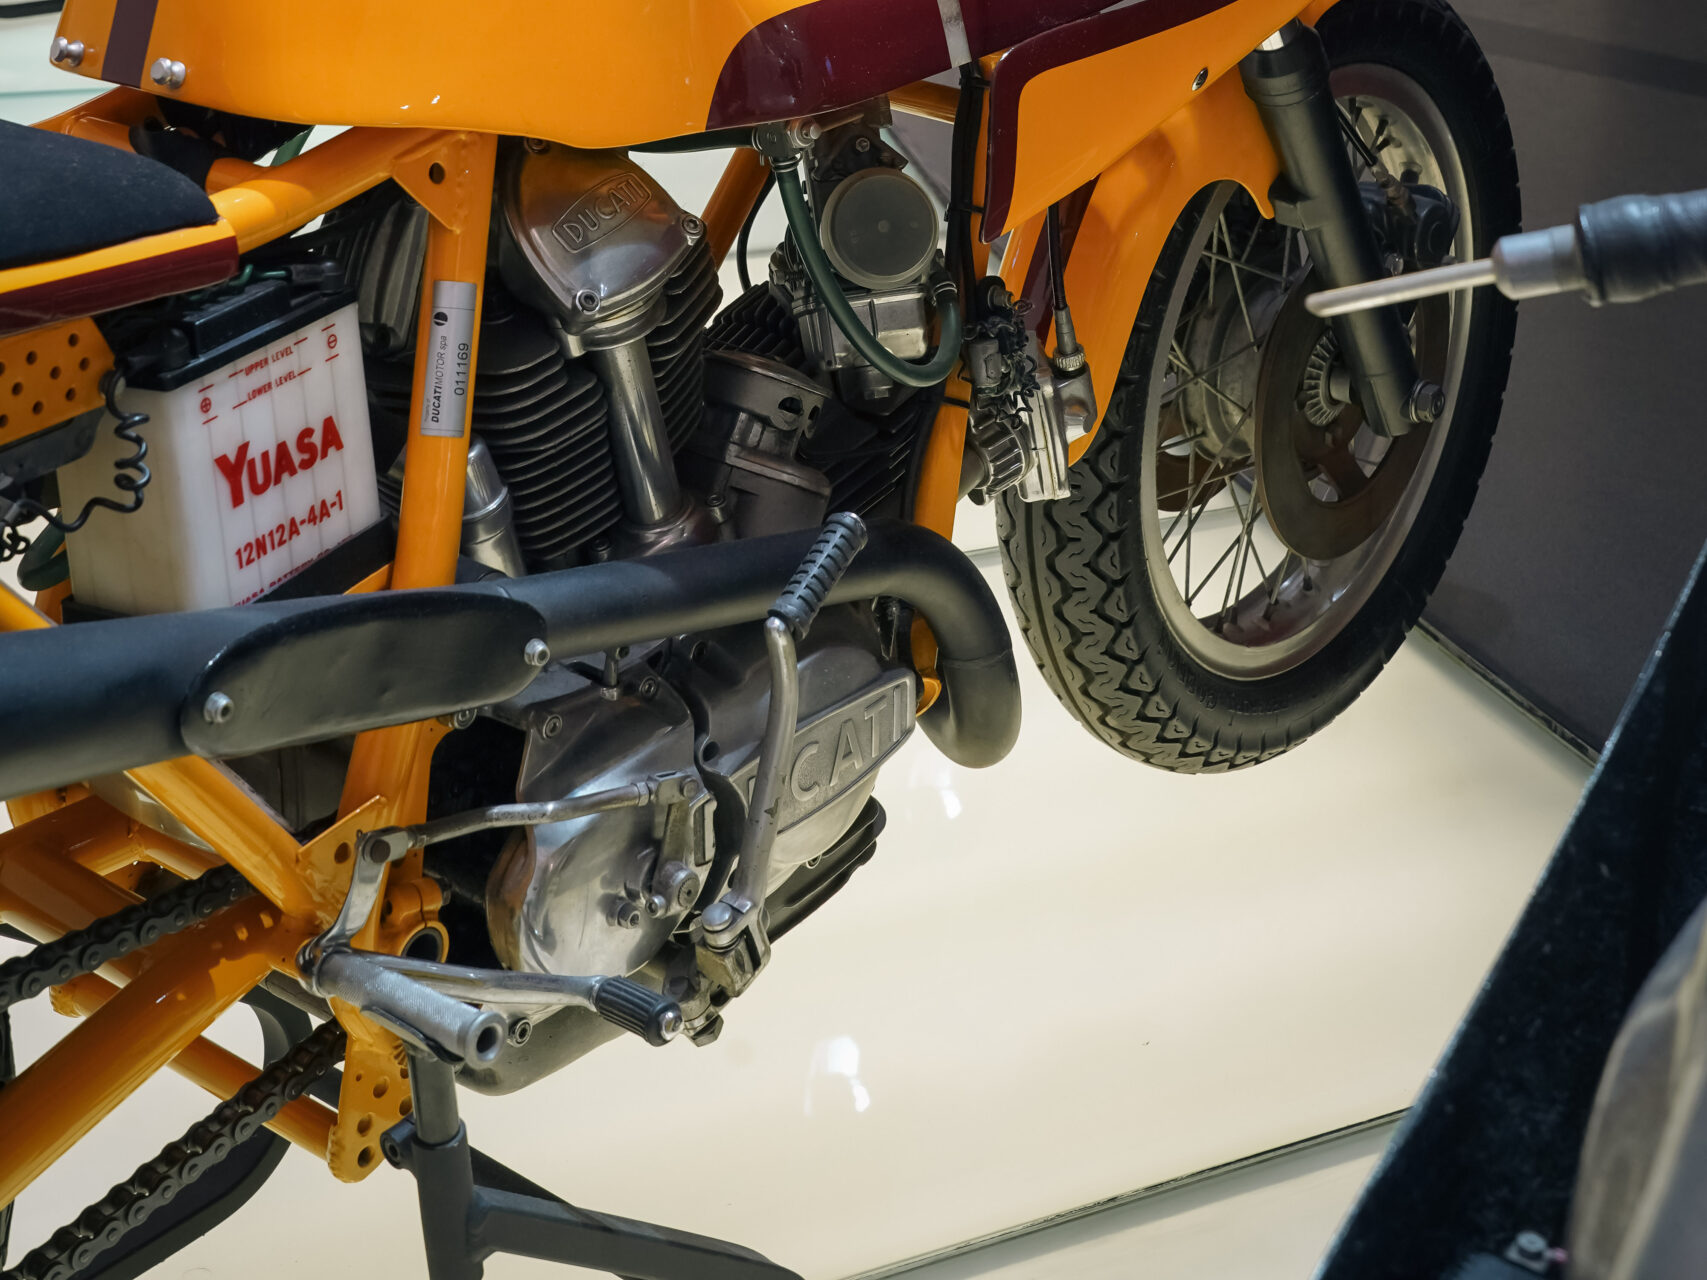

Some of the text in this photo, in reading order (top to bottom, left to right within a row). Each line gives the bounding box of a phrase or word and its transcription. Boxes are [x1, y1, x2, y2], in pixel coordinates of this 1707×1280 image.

[562, 178, 646, 244] DUCATI
[244, 346, 295, 377] UPPER LEVEL
[439, 335, 448, 351] spa
[454, 342, 469, 396] 011169
[247, 370, 298, 402] LOWER LEVEL
[213, 415, 345, 510] YUASA
[234, 489, 344, 570] 12N12A-4A-1
